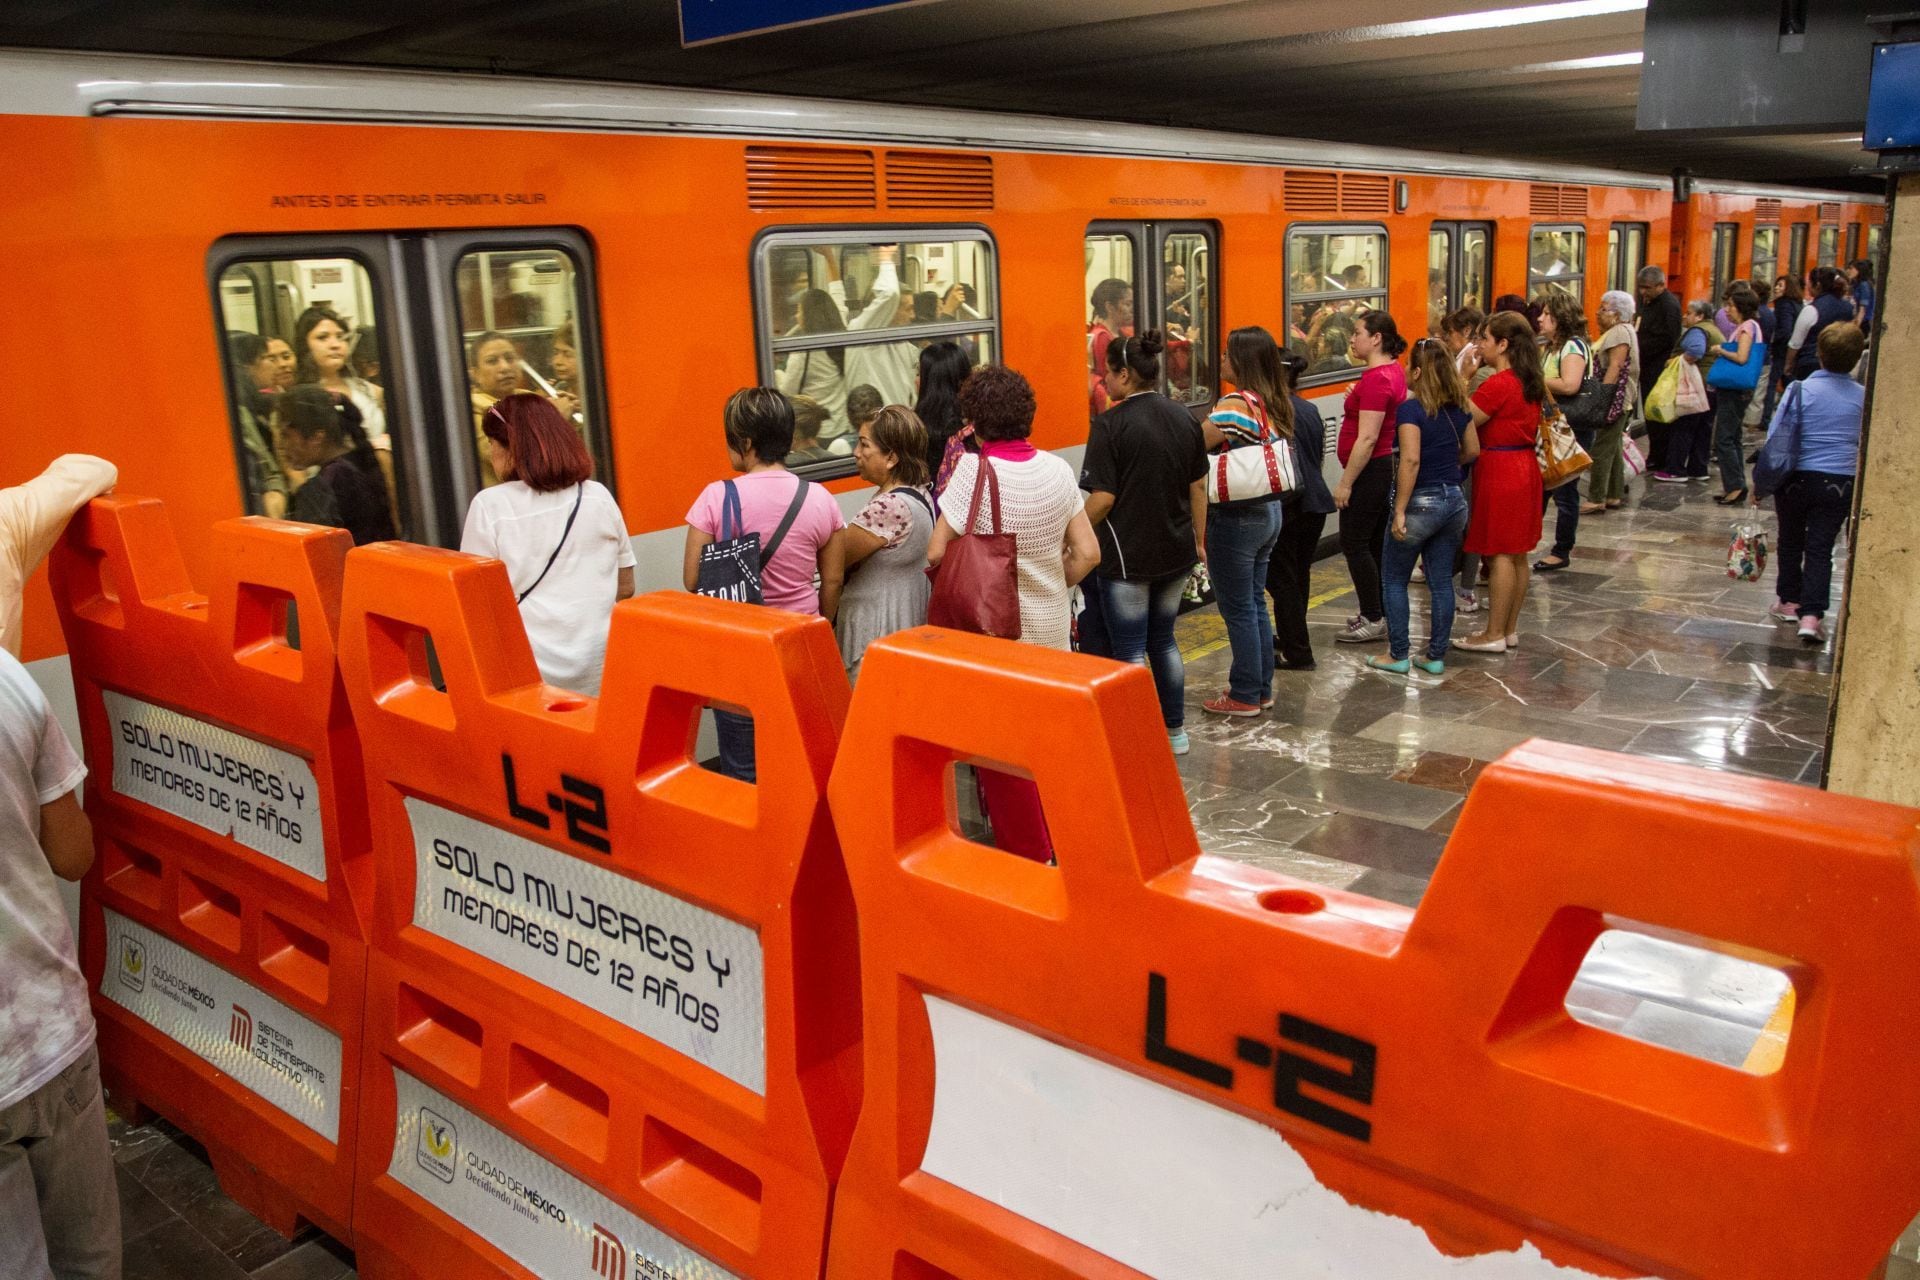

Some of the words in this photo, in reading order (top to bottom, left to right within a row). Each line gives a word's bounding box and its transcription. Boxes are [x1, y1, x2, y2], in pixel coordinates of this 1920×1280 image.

[271, 195, 331, 207] ANTES
[335, 194, 360, 207] DE
[363, 194, 431, 207] ENTRAR
[434, 193, 500, 206] PERMITA
[504, 193, 546, 205] SALIR
[121, 720, 174, 758] SOLO
[178, 740, 284, 802] MUJERES
[288, 781, 305, 810] Y
[131, 758, 205, 803] MENORES
[210, 787, 231, 813] DE
[236, 797, 251, 823] 12
[256, 806, 303, 844] AÑOS
[501, 752, 612, 856] L-2
[433, 838, 515, 896] SOLO
[523, 872, 695, 974] MUJERES
[706, 949, 731, 989] Y
[152, 965, 178, 988] CIUDAD
[178, 980, 188, 993] DE
[188, 985, 215, 1010] MÉXICO
[443, 887, 559, 957] MENORES
[567, 939, 600, 977] DE
[609, 958, 634, 993] 12
[642, 976, 720, 1034] AÑOS
[255, 1048, 302, 1084] COLECTIVO
[257, 1034, 268, 1049] DE
[270, 1041, 325, 1084] TRANSPORTE
[258, 1021, 294, 1050] SISTEMA
[1145, 970, 1378, 1144] L-2
[465, 1168, 511, 1206] Decidiendo
[467, 1151, 507, 1185] CIUDAD
[507, 1176, 523, 1197] DE
[523, 1186, 566, 1223] MÉXICO
[635, 1253, 678, 1280] SISTE
